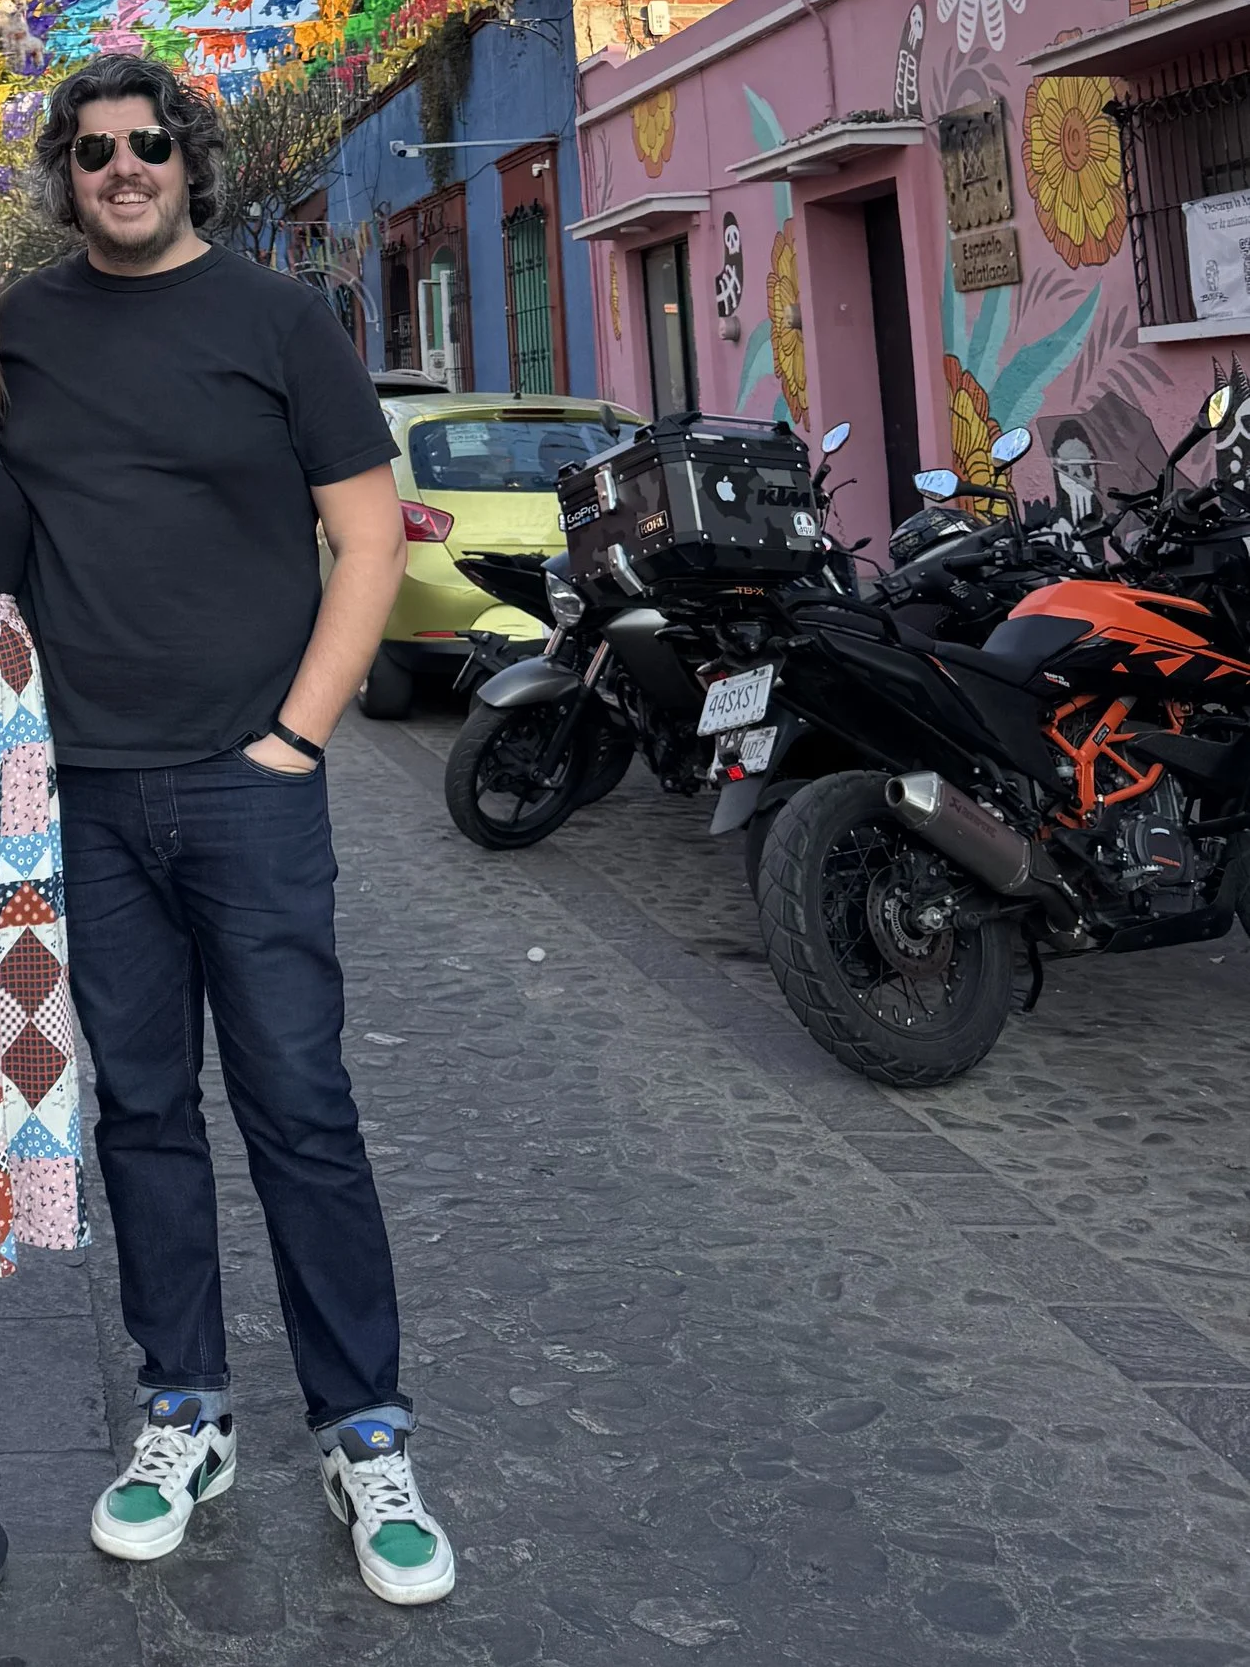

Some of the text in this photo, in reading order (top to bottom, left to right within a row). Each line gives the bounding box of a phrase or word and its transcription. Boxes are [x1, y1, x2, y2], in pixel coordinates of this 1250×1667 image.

[962, 235, 1002, 264] Espacio
[962, 264, 1009, 286] Jalatlaco
[757, 485, 811, 507] KTM
[566, 503, 599, 524] GoPro
[708, 682, 761, 718] 44SXS1
